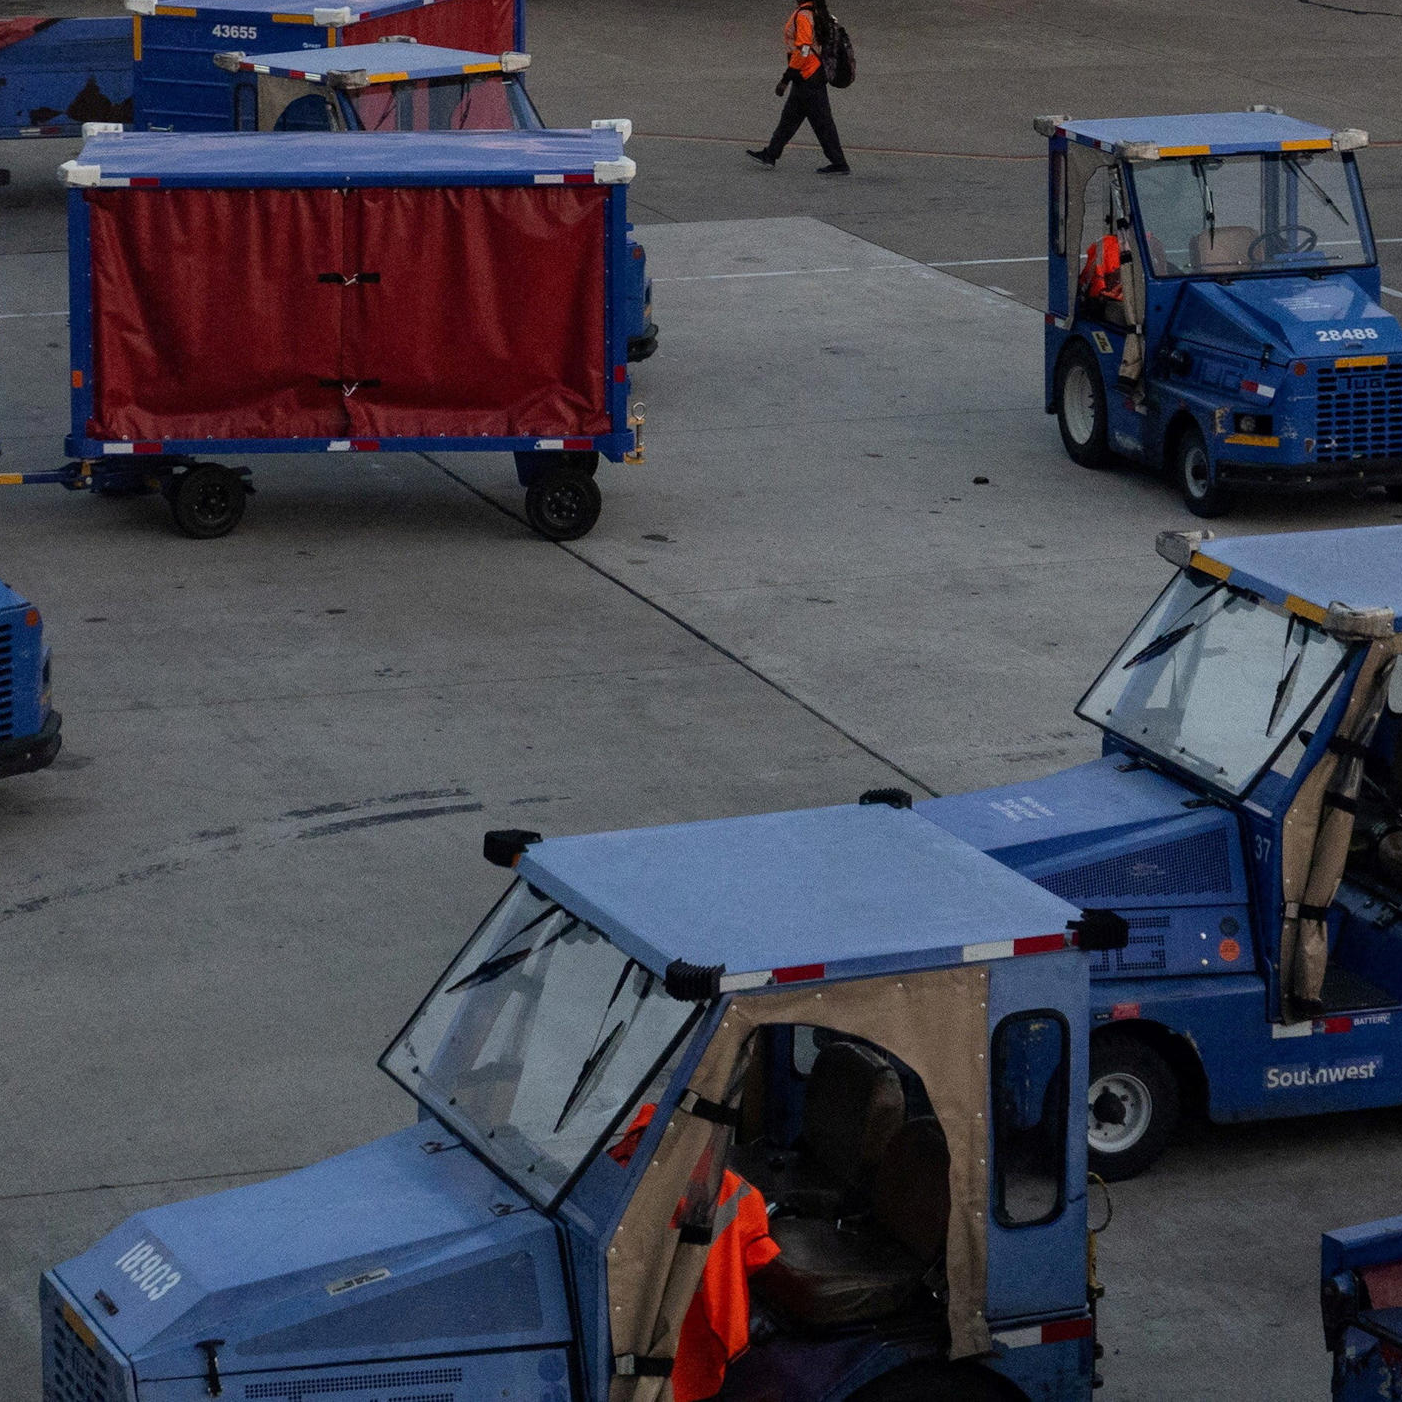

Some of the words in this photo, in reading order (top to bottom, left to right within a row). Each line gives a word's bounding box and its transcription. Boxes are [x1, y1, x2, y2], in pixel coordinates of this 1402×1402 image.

[212, 24, 258, 40] 43655
[1316, 327, 1379, 343] 28488
[1254, 834, 1272, 863] 37
[1266, 1062, 1378, 1091] Southwest
[114, 1238, 183, 1302] 18903
